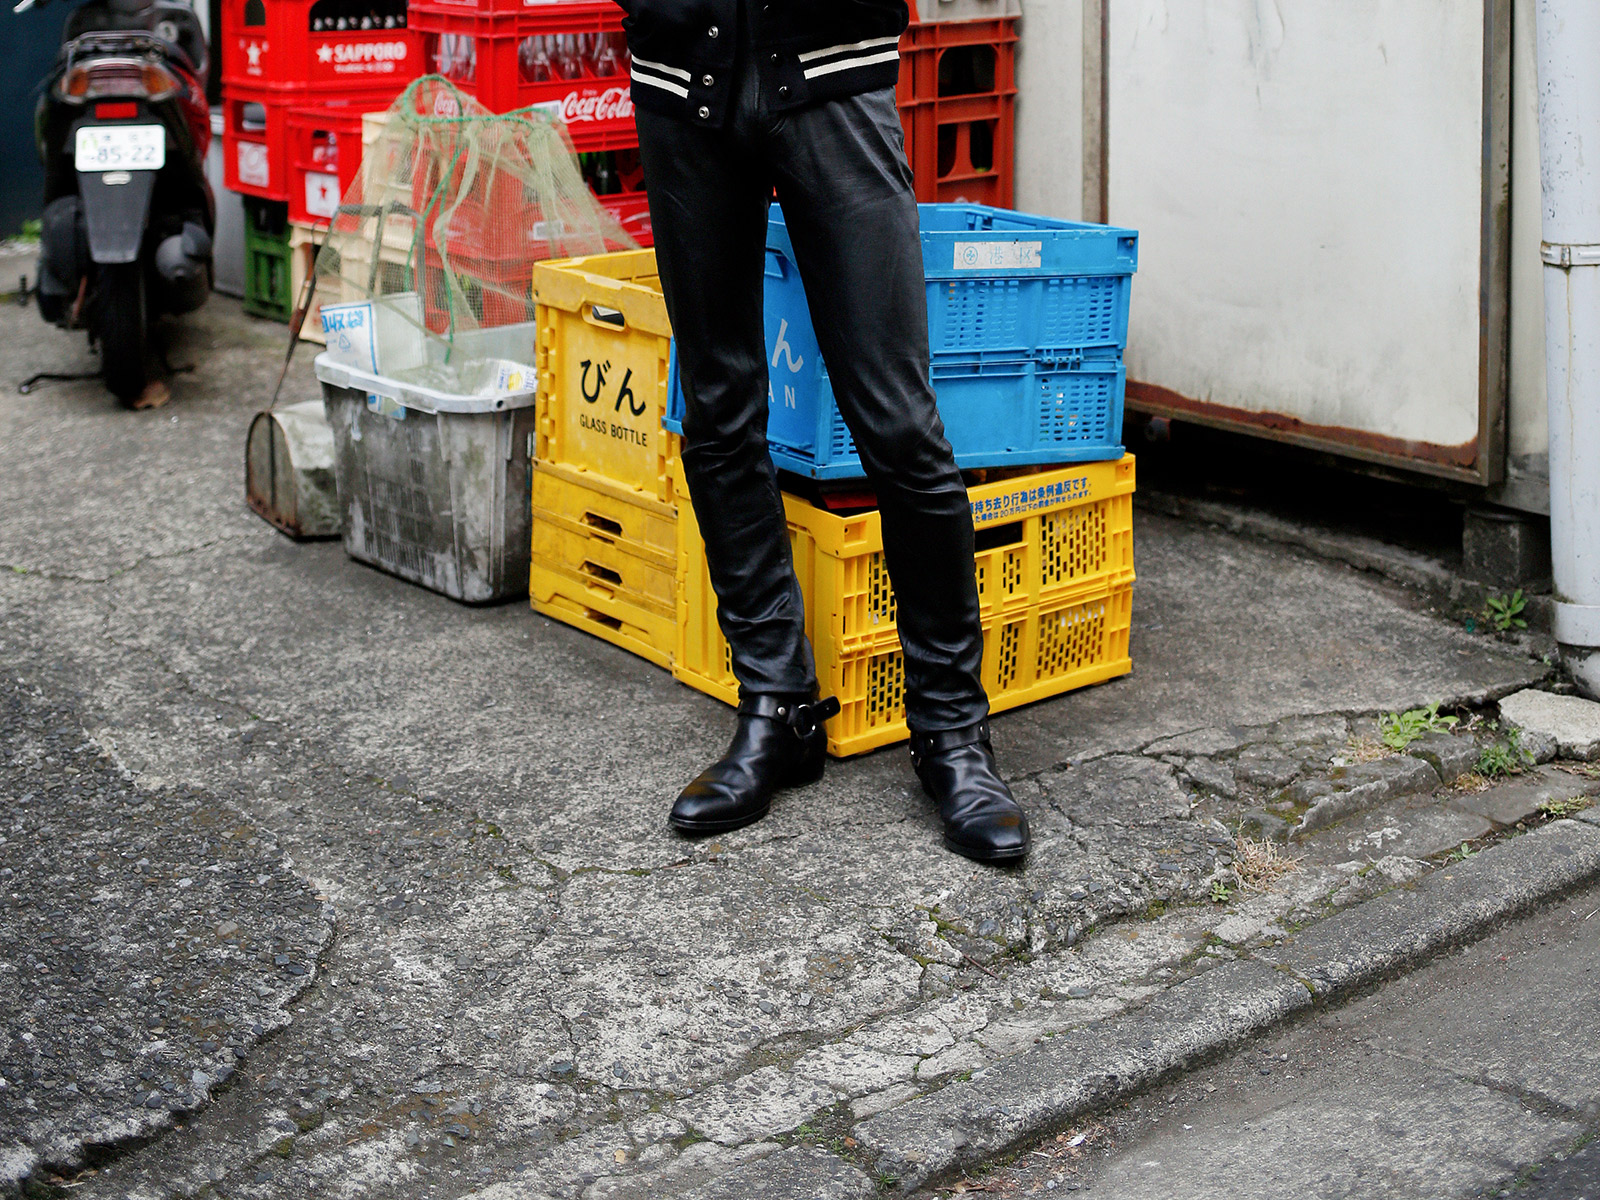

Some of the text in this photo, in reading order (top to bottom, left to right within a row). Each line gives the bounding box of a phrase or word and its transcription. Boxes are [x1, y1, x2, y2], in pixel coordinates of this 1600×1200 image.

[333, 41, 407, 62] SAPPORO
[771, 318, 804, 373] ん
[580, 359, 646, 416] びん
[580, 413, 648, 447] GLASS BOTTLE
